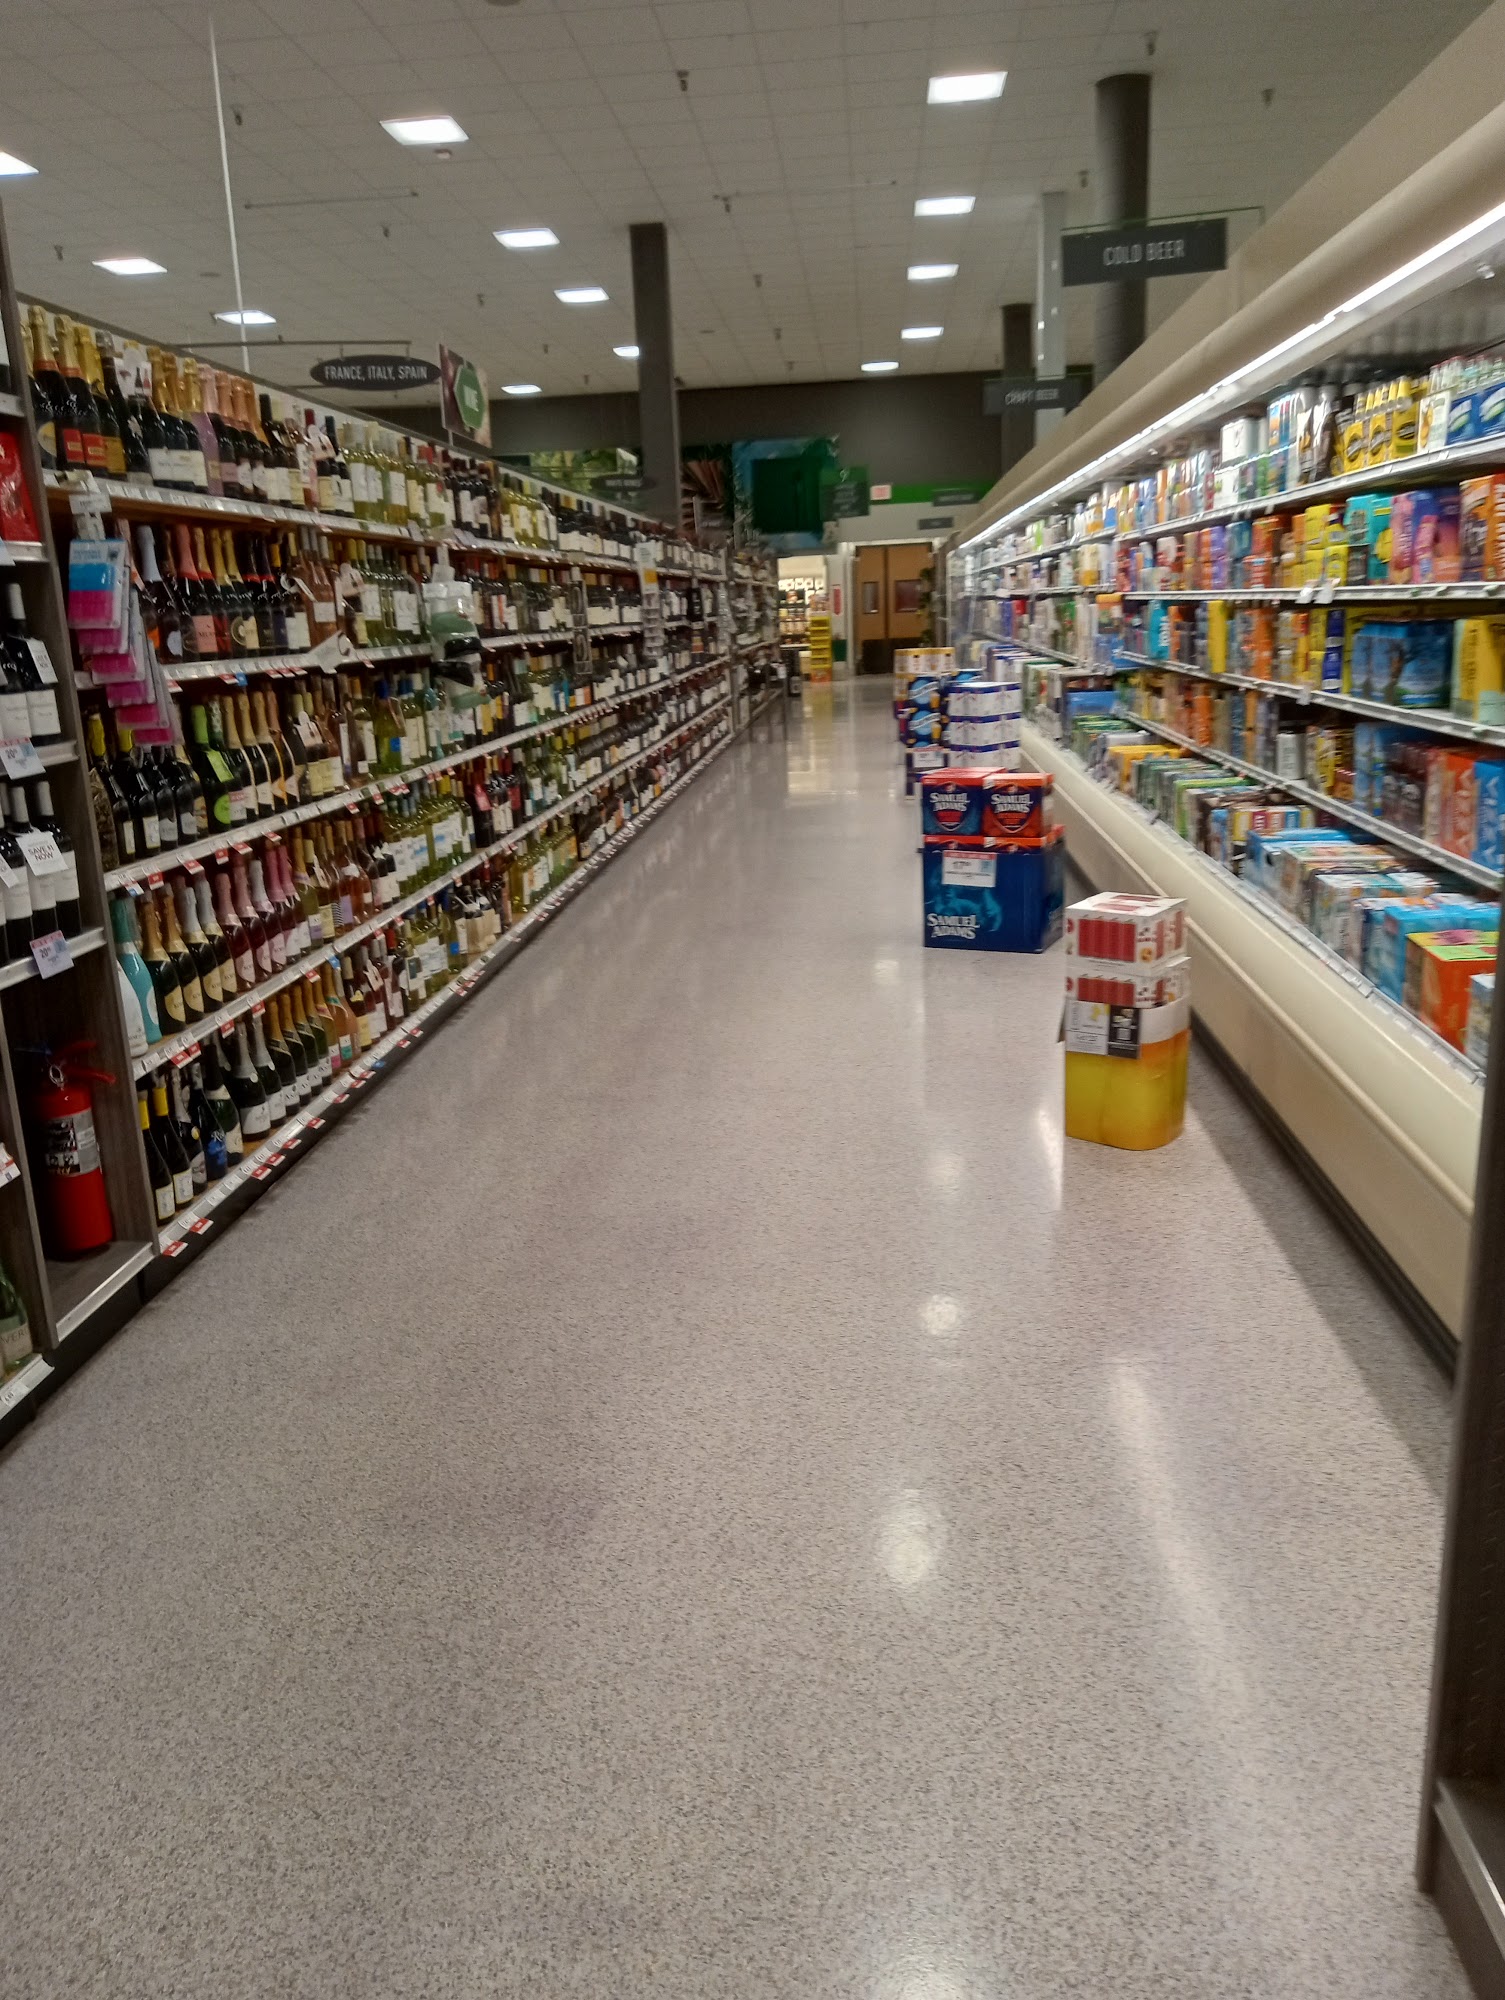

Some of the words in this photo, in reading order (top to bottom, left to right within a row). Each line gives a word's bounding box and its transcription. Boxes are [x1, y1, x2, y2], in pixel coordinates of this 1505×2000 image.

[1103, 244, 1142, 266] COLD
[1146, 240, 1185, 261] BEER
[324, 365, 366, 382] FRANCE,
[368, 365, 395, 381] ITALY,
[398, 366, 427, 380] SPAIN
[930, 792, 970, 803] SAMUEL
[991, 793, 1033, 804] SAMUEL
[933, 801, 967, 812] ADAMS
[995, 803, 1030, 814] ADAMS
[927, 913, 980, 928] SAMUEL
[931, 926, 976, 940] ADAMS
